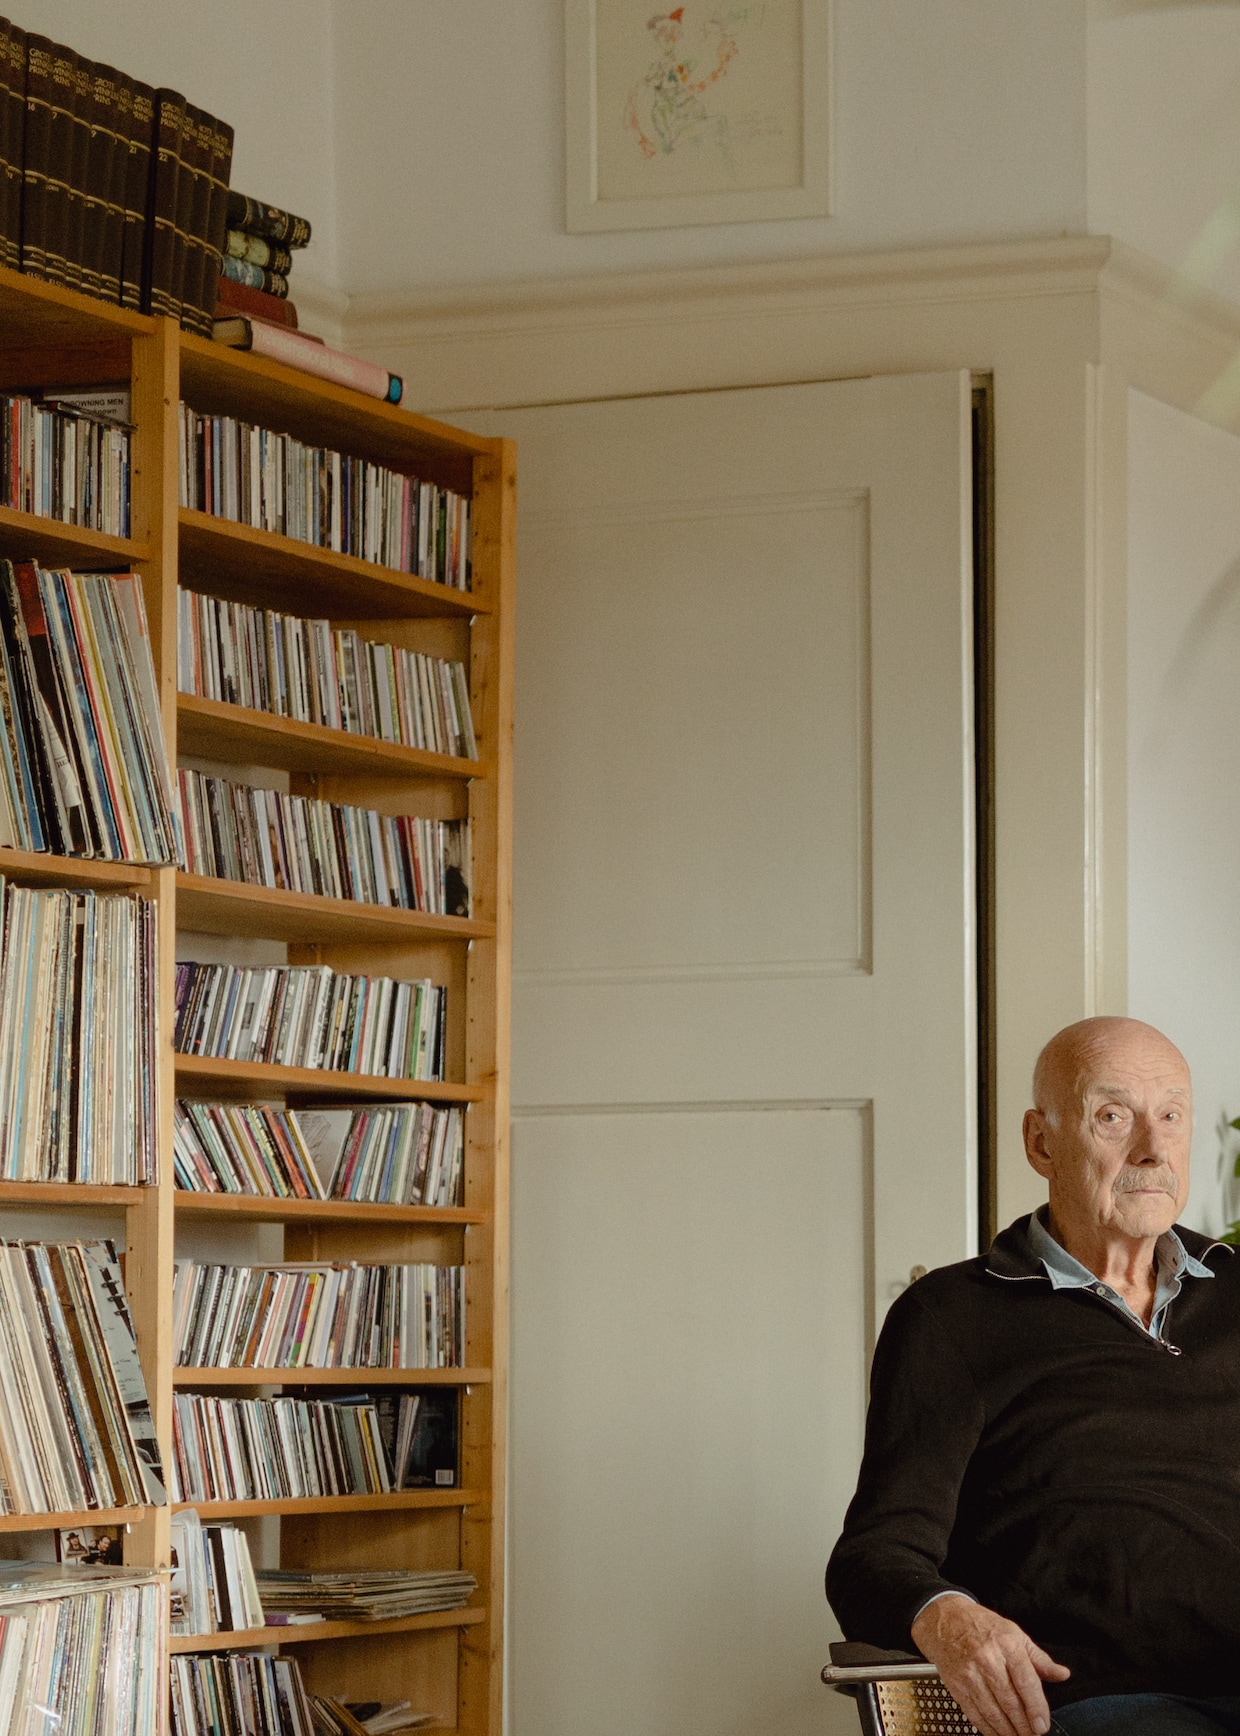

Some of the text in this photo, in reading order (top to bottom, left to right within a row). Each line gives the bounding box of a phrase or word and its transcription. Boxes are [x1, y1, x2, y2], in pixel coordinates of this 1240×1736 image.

[28, 102, 36, 111] 16
[159, 153, 168, 162] 22
[69, 398, 124, 408] ROWNING MEN
